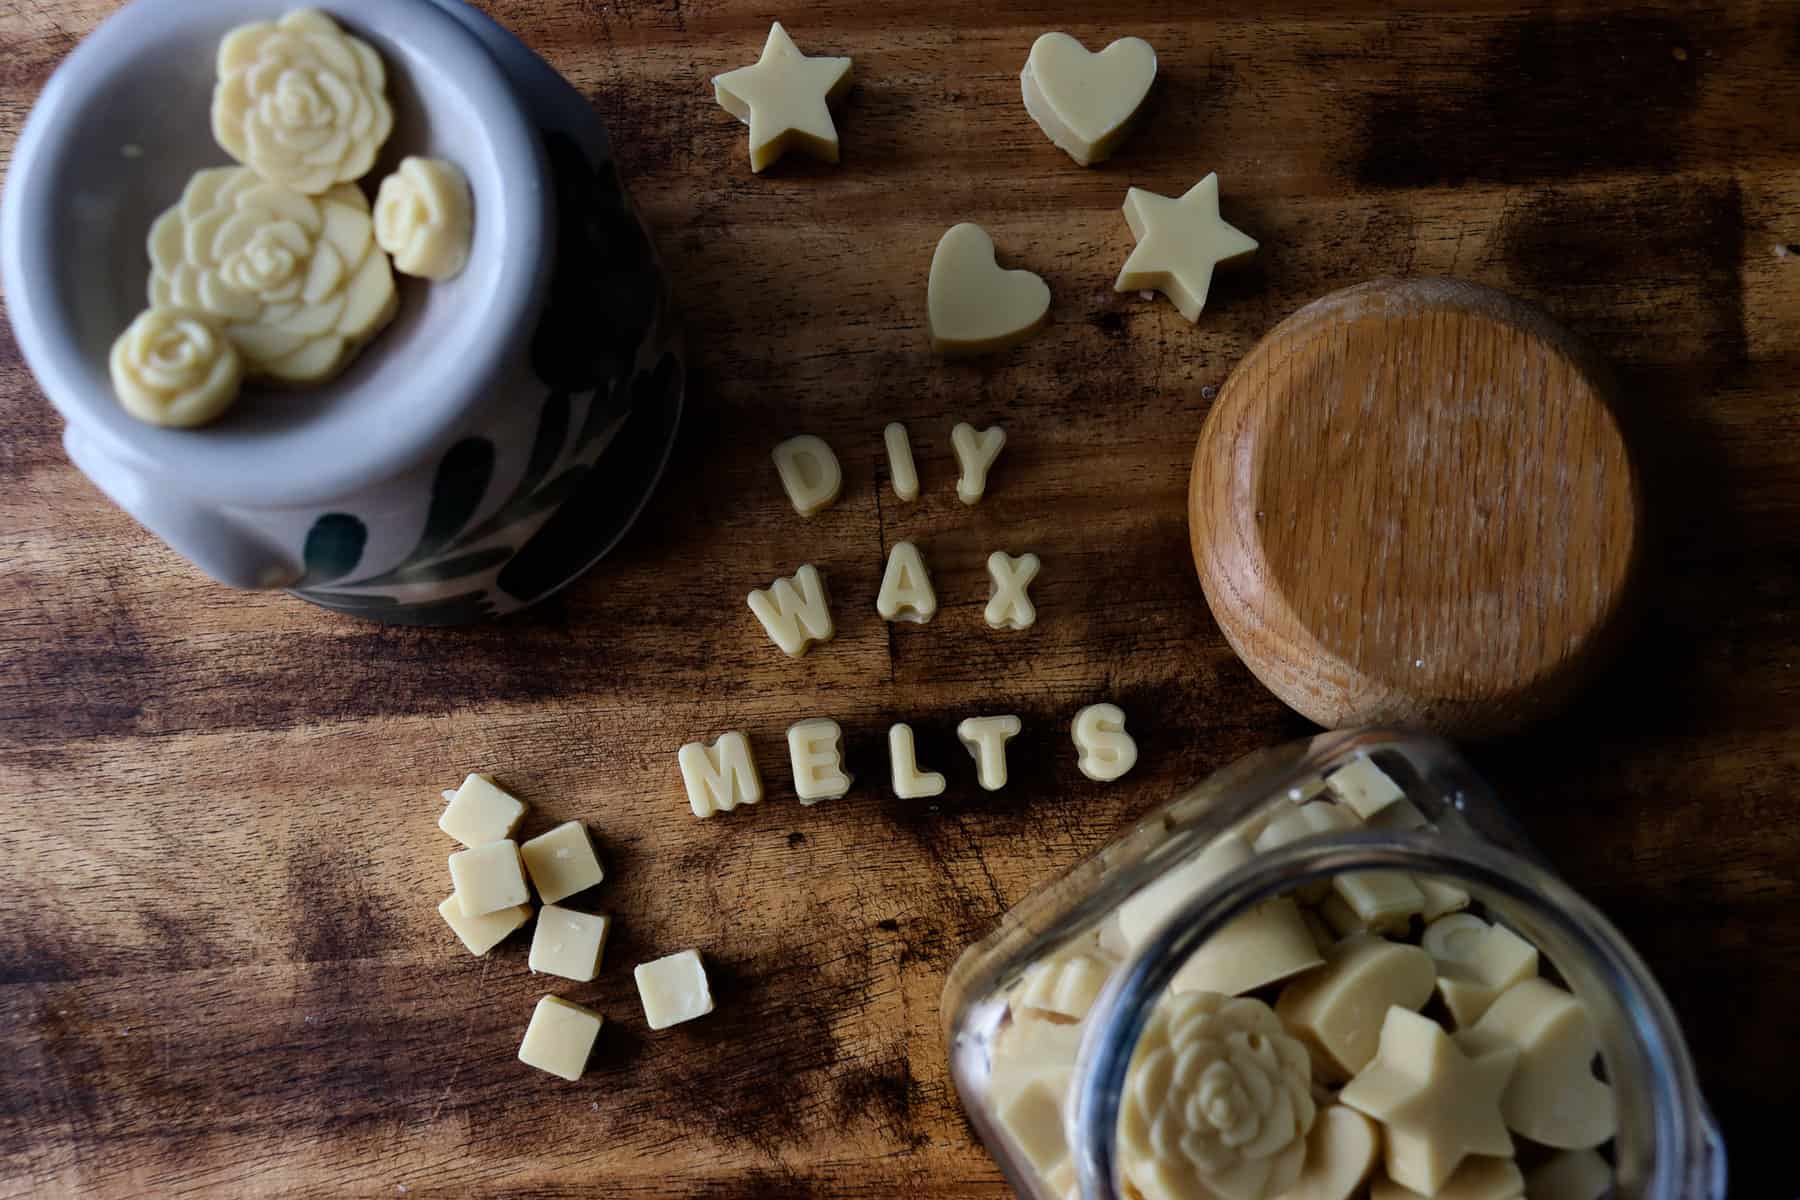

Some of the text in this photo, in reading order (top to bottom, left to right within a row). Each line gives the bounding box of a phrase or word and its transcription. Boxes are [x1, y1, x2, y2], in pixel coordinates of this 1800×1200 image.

[772, 422, 1007, 517] DIY
[747, 541, 1040, 657] WAX
[678, 702, 1138, 817] MELTS
